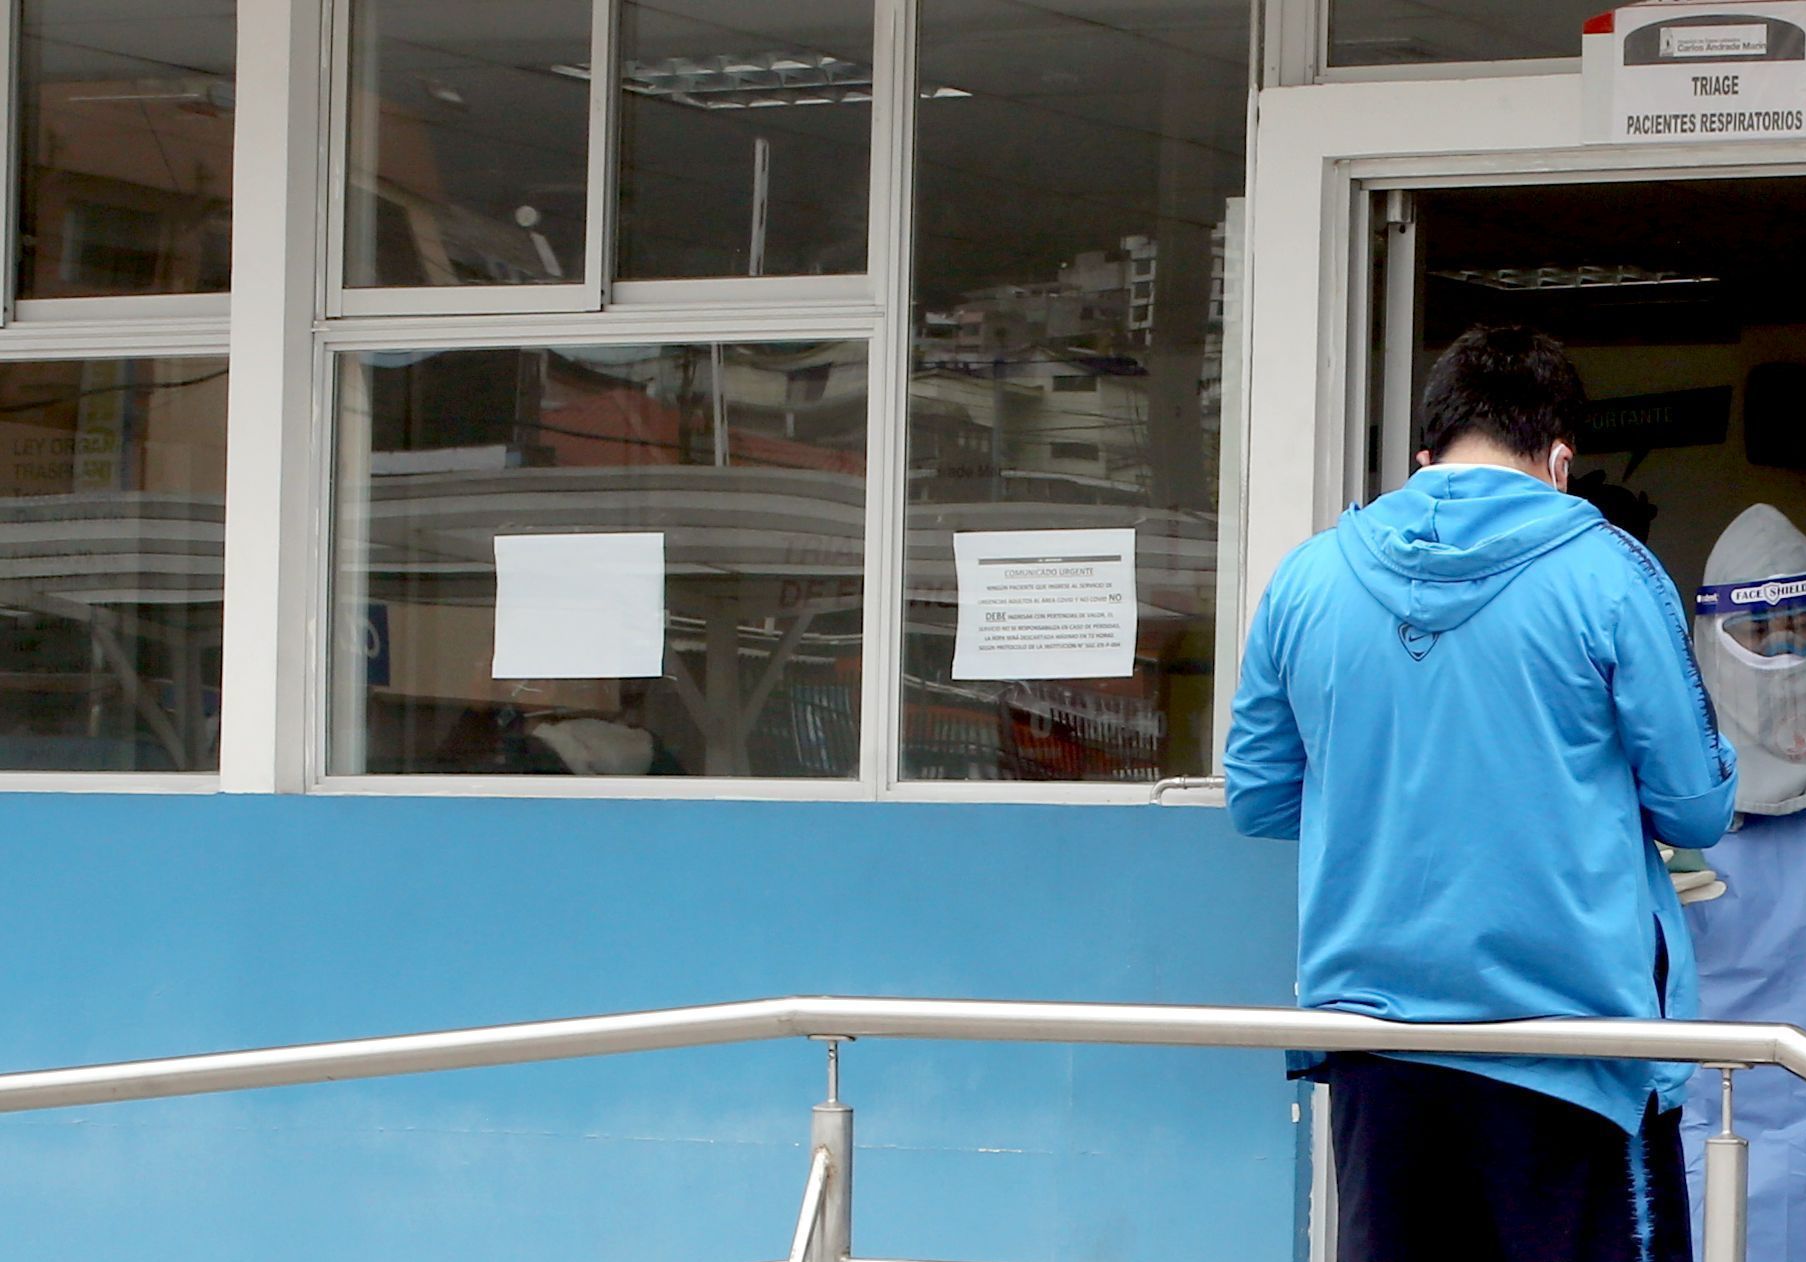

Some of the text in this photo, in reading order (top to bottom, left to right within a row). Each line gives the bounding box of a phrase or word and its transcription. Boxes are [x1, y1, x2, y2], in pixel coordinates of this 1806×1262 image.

[1692, 75, 1739, 96] TRIAGE
[1626, 110, 1803, 135] PACIENTES RESPIRATORIOS
[1004, 568, 1094, 577] COMUNICADO URGENTE
[1109, 594, 1122, 602] NO
[1736, 589, 1763, 601] FACE
[986, 612, 1006, 621] DEBE
